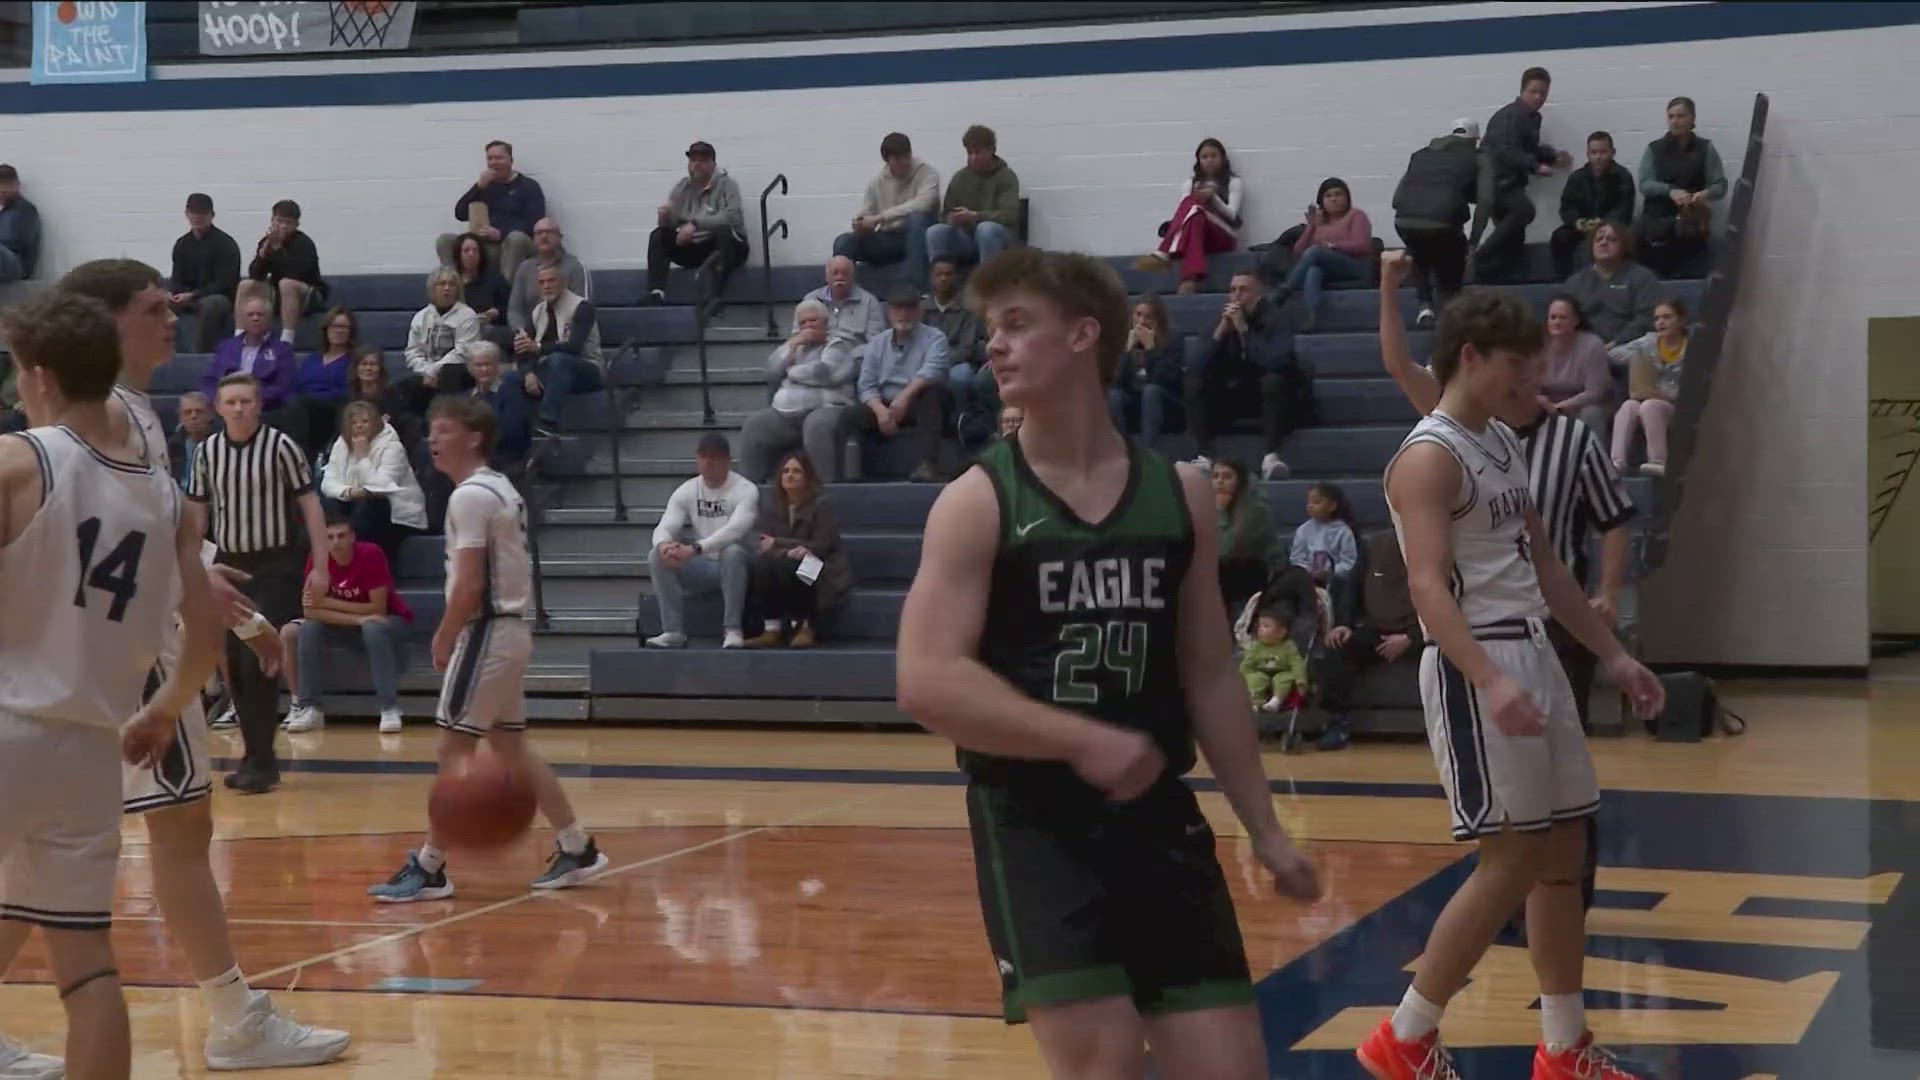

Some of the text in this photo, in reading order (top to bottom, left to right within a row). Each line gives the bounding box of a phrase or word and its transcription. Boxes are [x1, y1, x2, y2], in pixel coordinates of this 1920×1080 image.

[69, 25, 112, 45] THE
[205, 12, 300, 50] HOOP!
[48, 43, 128, 72] PAINT
[73, 516, 147, 623] 14
[1039, 558, 1165, 613] EAGLE
[1053, 621, 1147, 703] 24
